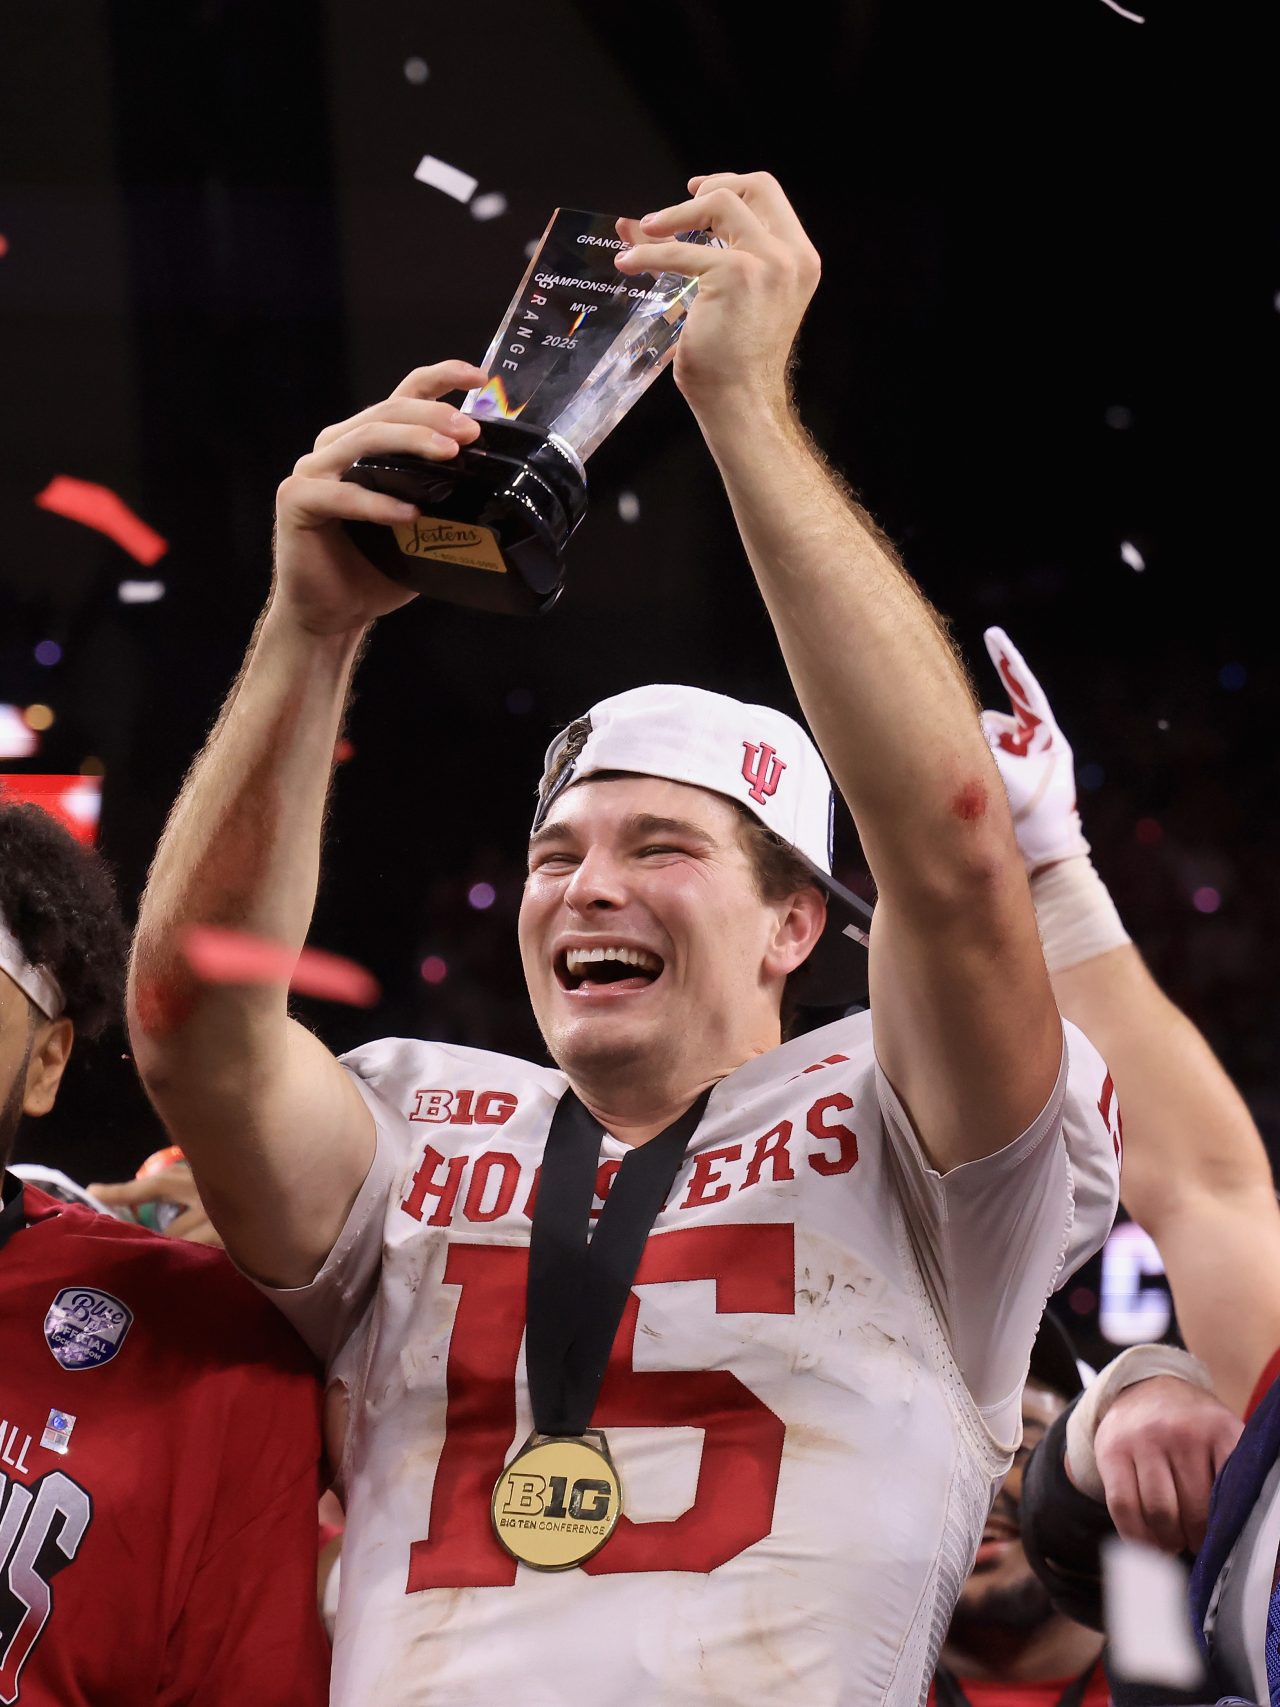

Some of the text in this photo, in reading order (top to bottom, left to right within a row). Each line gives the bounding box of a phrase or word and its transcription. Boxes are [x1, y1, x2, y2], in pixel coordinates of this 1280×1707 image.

[534, 272, 666, 302] CHAMPIONSHIP GAME
[570, 302, 598, 314] MVP
[502, 278, 554, 372] GRANGE
[541, 335, 579, 350] 2025
[406, 521, 482, 553] Jostens
[406, 1222, 796, 1594] 15
[500, 1518, 606, 1535] BIG TEN CONFERENCE
